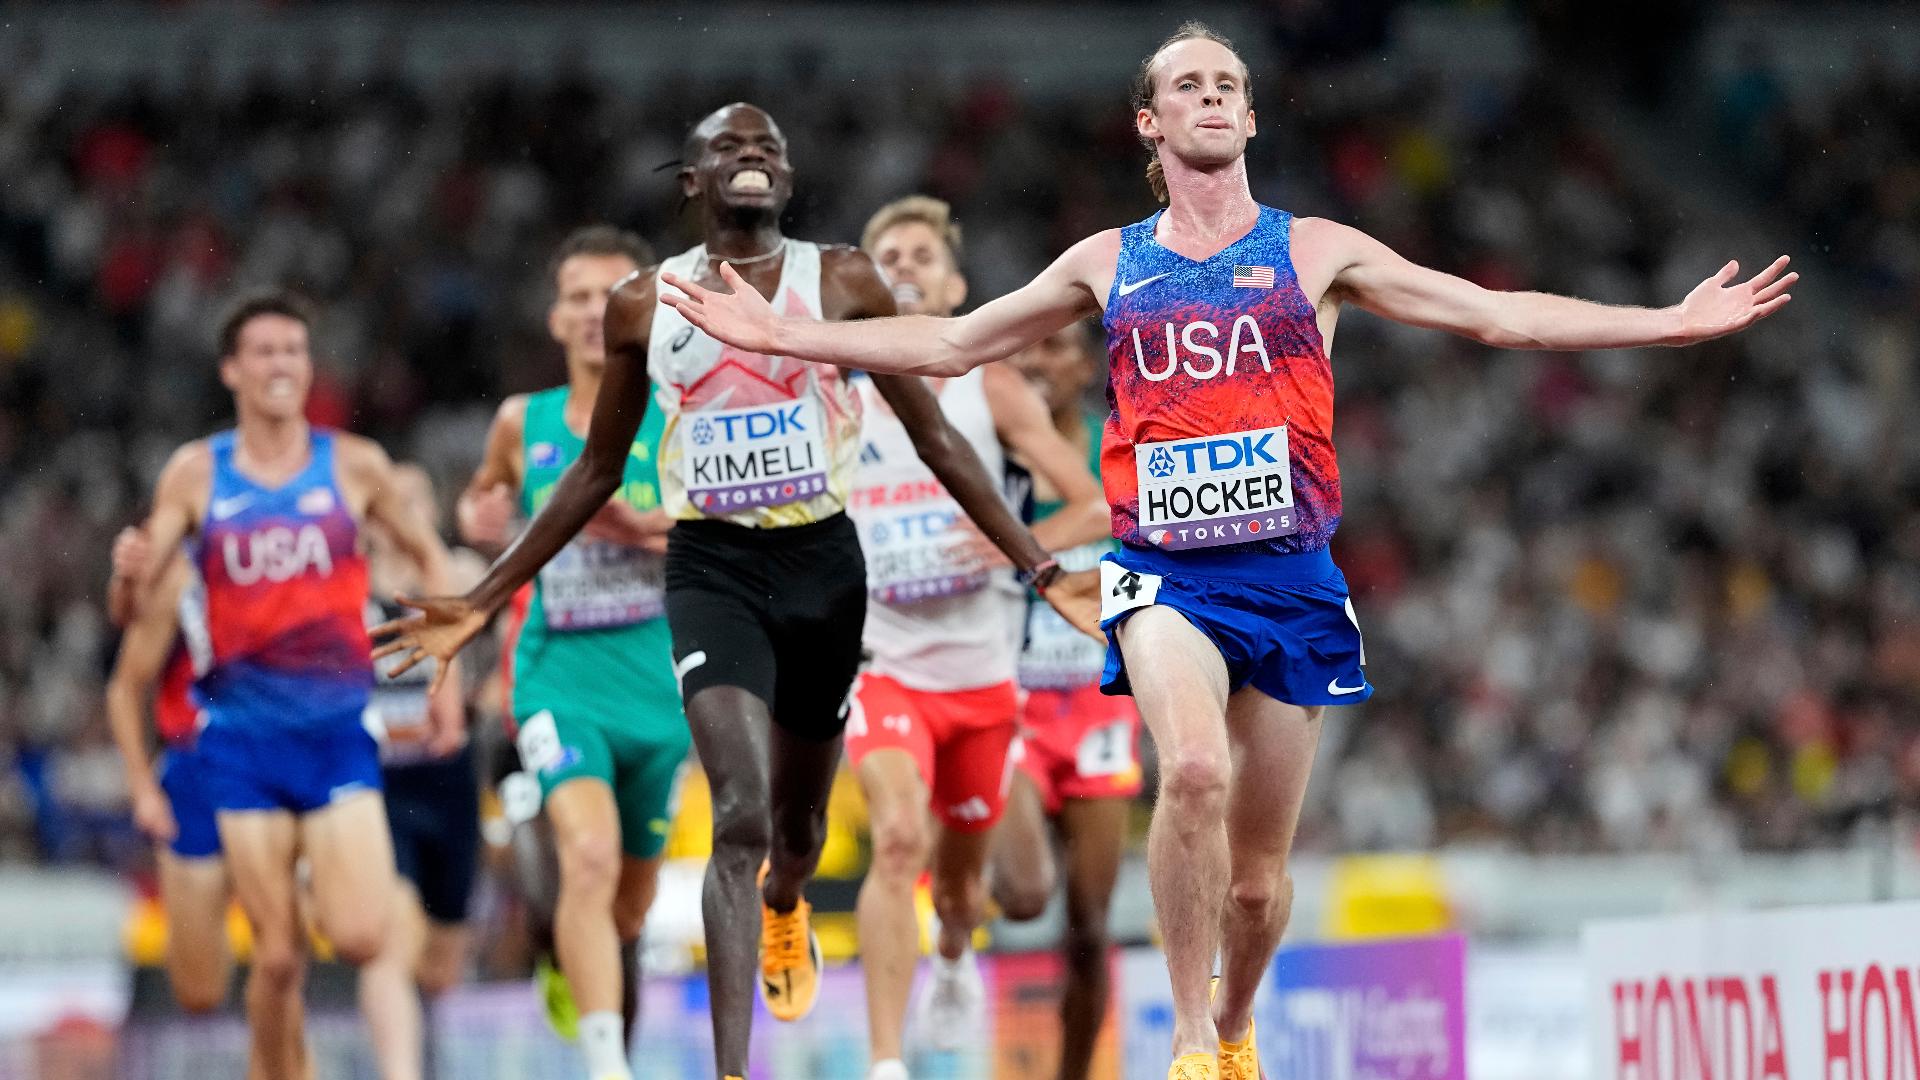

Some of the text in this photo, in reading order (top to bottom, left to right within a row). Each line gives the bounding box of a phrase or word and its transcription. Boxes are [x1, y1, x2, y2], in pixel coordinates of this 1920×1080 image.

[1132, 314, 1271, 381] USA
[714, 404, 806, 442] TDK
[691, 441, 814, 484] KIMELI
[1173, 433, 1278, 474] TDK
[1148, 473, 1284, 521] HOCKER
[223, 524, 333, 586] USA
[1112, 571, 1143, 600] 4
[1613, 975, 1789, 1080] HONDA
